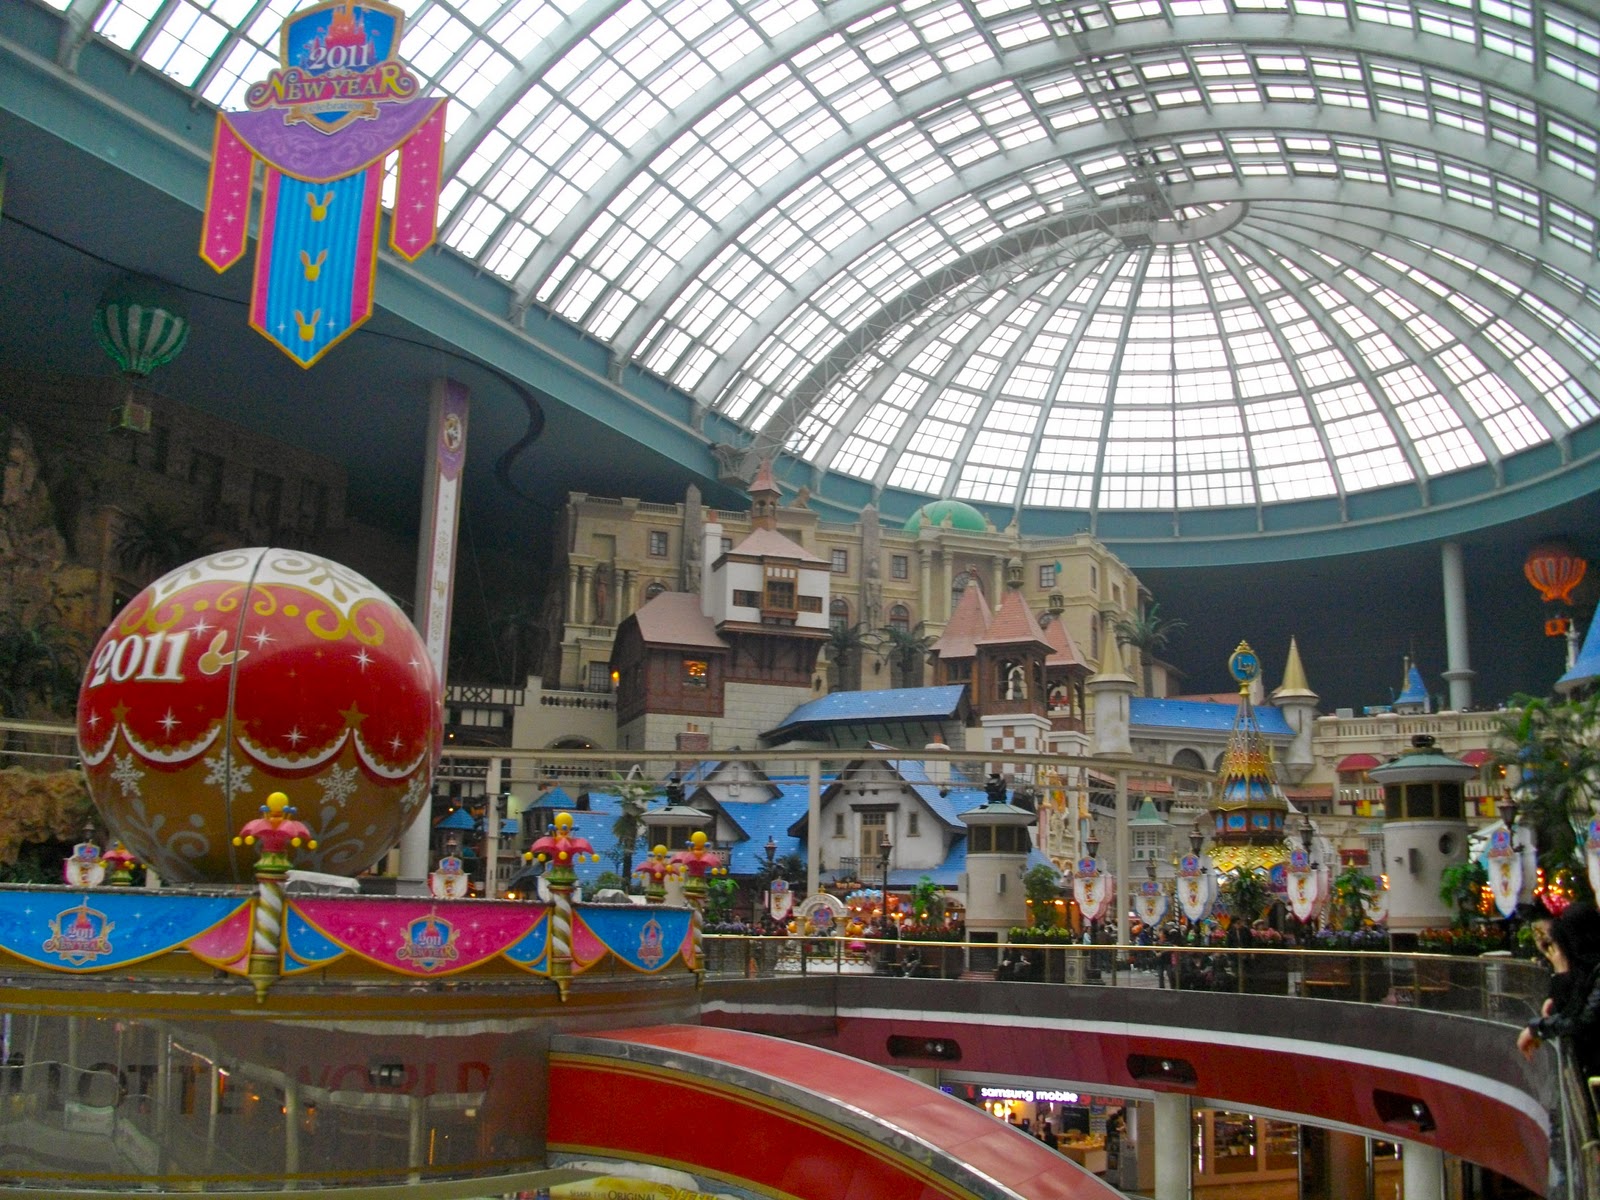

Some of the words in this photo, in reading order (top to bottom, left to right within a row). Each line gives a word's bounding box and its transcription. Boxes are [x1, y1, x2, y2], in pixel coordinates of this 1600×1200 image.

[309, 44, 370, 70] 2011
[249, 71, 327, 105] NEW
[331, 65, 413, 99] YEAR
[89, 631, 189, 688] 2011
[981, 1087, 1034, 1102] samsung
[1036, 1089, 1078, 1103] mobile
